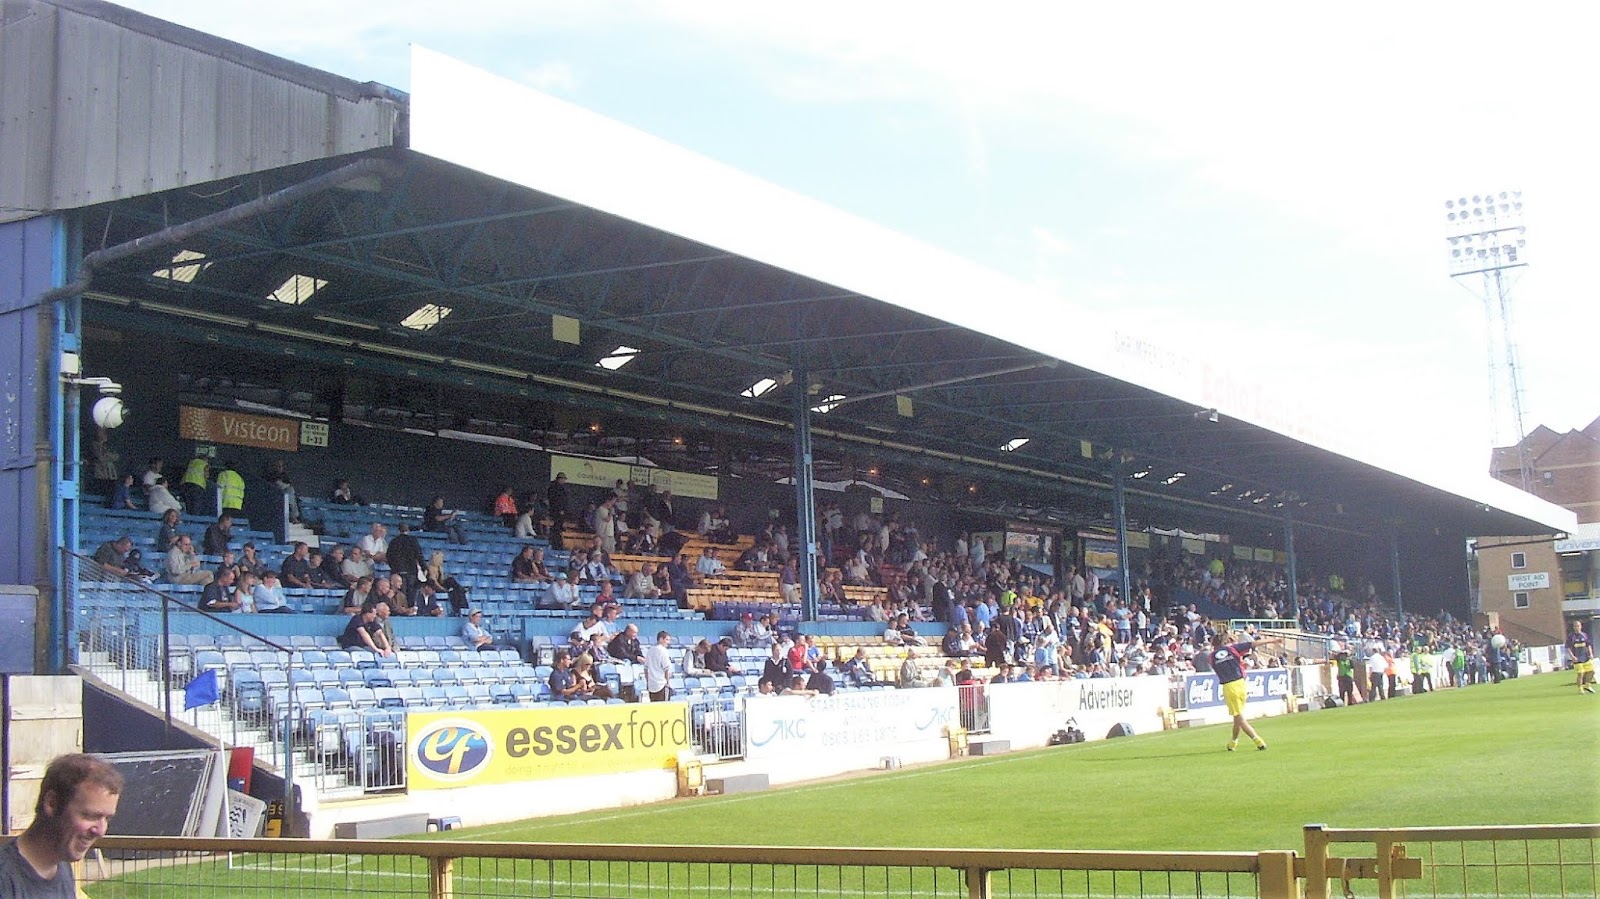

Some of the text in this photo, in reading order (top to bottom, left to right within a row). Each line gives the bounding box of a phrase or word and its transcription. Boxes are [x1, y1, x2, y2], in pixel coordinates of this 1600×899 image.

[222, 416, 291, 443] Visteon
[810, 697, 840, 712] START
[1078, 681, 1134, 711] Advertiser
